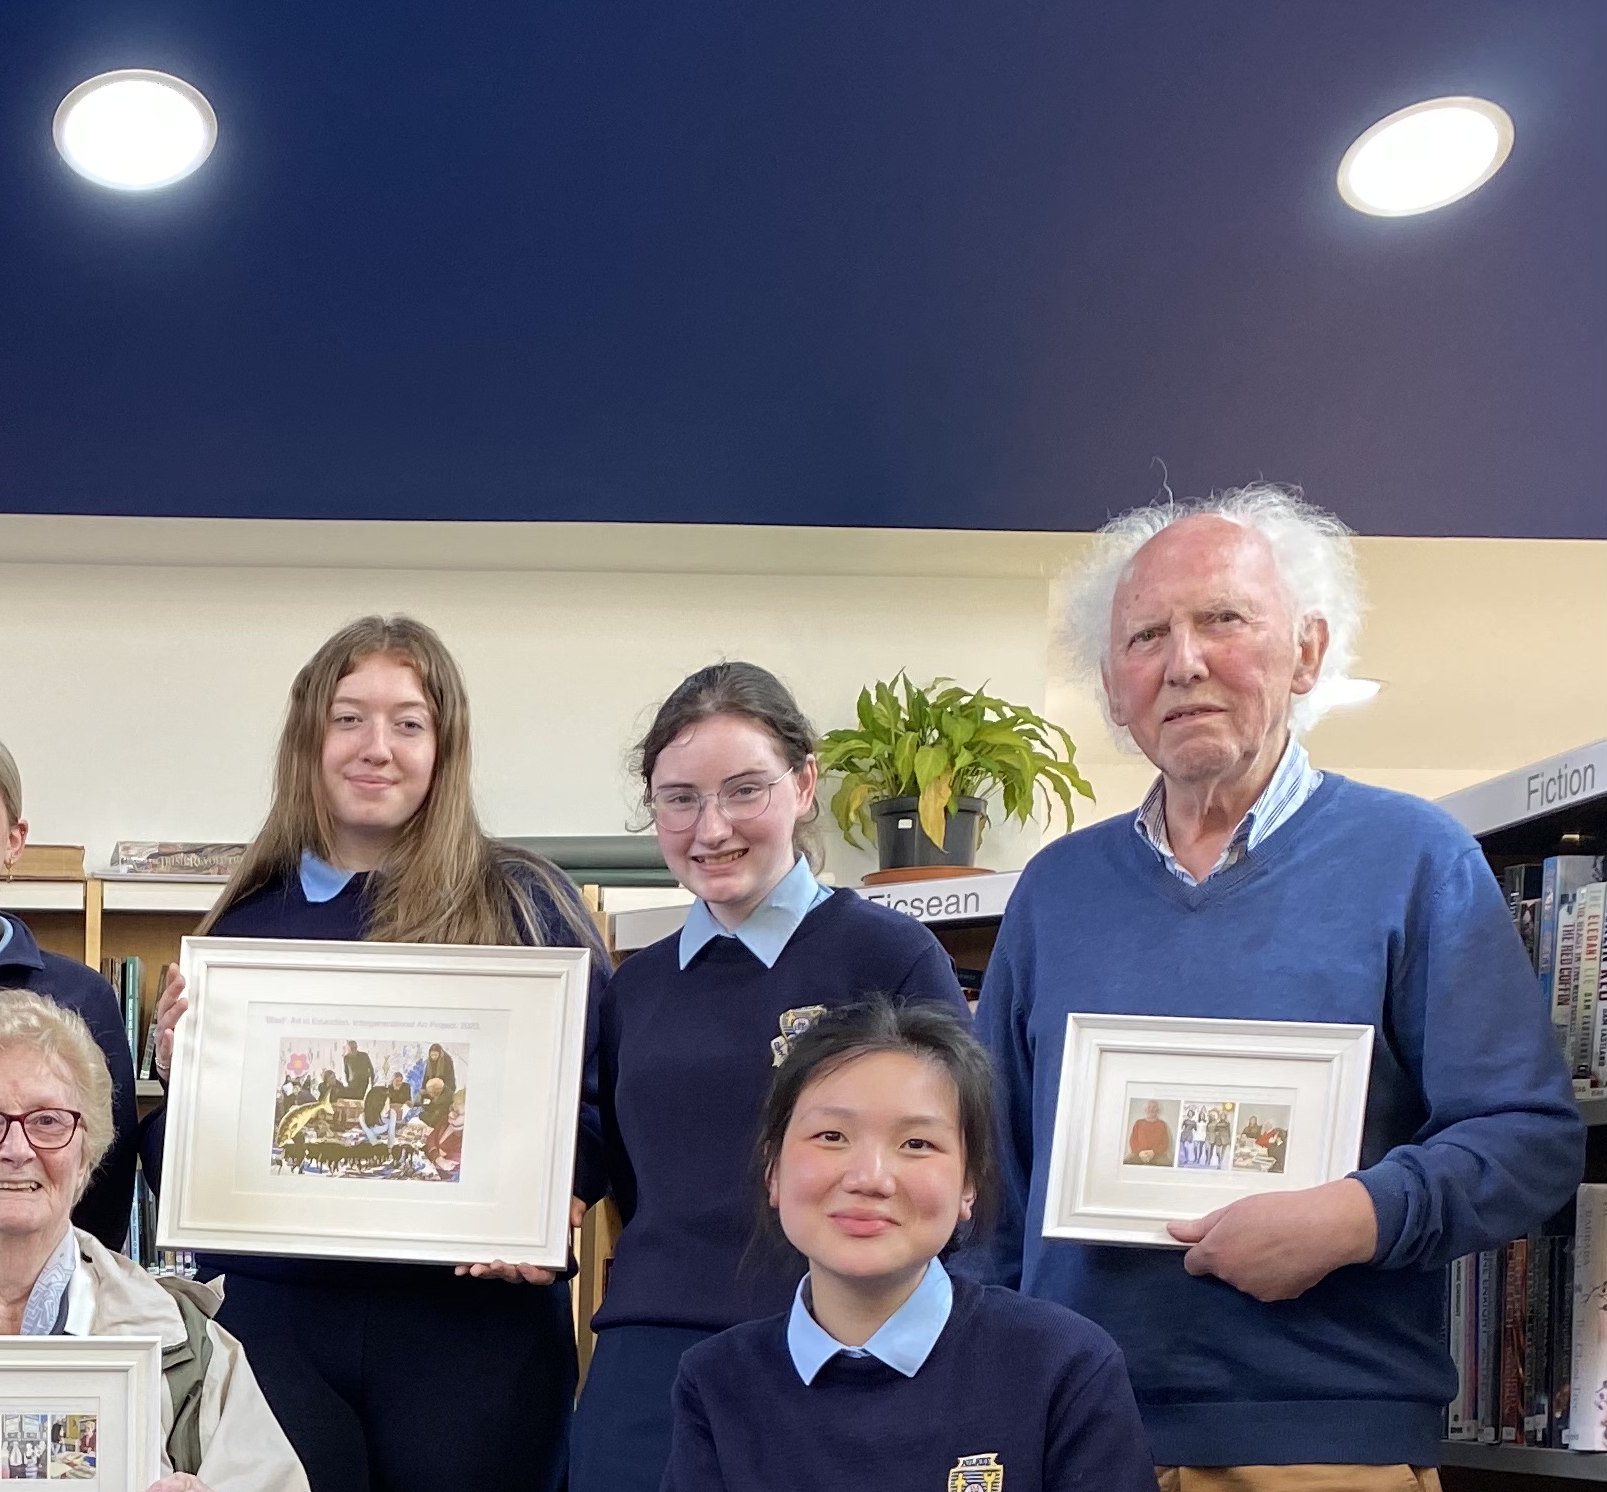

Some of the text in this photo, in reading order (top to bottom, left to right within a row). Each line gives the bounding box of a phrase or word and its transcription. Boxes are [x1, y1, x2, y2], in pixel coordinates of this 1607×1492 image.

[1527, 763, 1594, 810] Fiction
[868, 891, 980, 918] icsean
[1585, 914, 1599, 963] ELEGANT
[1558, 923, 1576, 1006] THE RED COFFIN
